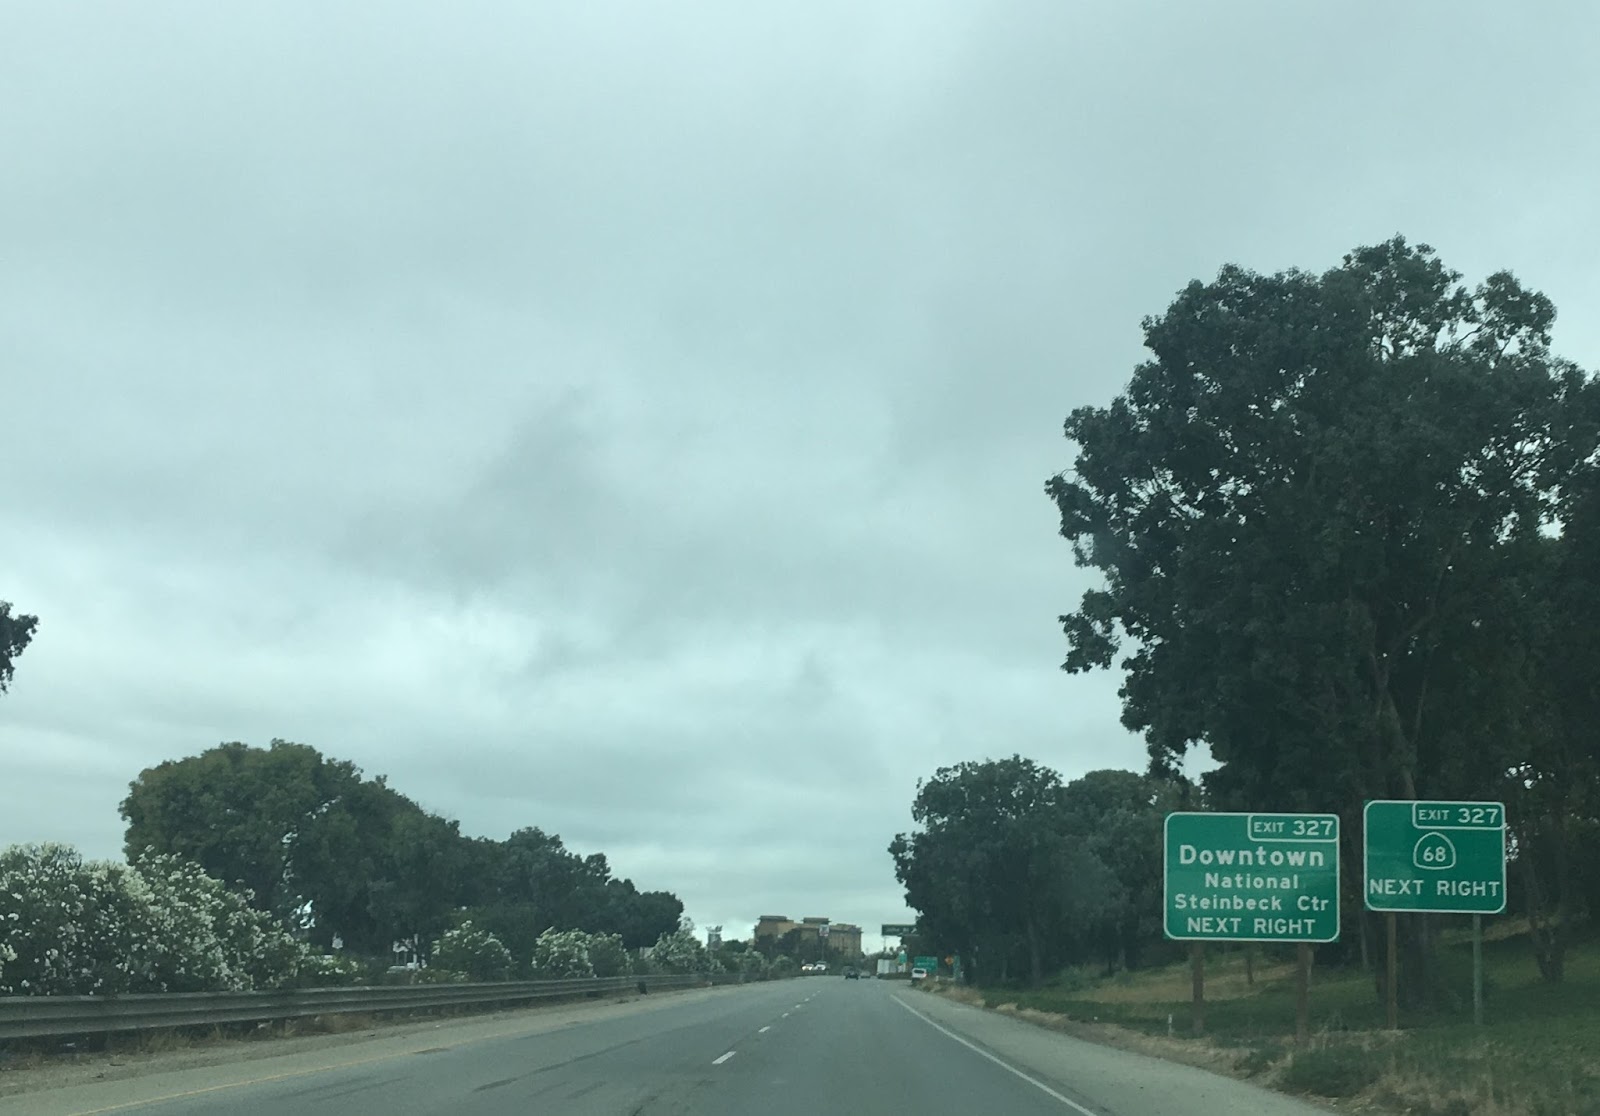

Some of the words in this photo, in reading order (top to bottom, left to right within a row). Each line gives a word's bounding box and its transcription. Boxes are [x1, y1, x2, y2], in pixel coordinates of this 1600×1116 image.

[1418, 809, 1450, 821] EXIT
[1458, 808, 1499, 824] 327
[1254, 822, 1285, 833] EXIT
[1293, 820, 1334, 836] 327
[1179, 844, 1324, 867] Downtown
[1423, 846, 1446, 862] 68
[1205, 873, 1299, 889] National
[1369, 879, 1424, 895] NEXT
[1436, 880, 1500, 897] RIGHT
[1174, 893, 1282, 911] Steinbeck
[1297, 896, 1329, 911] Ctr
[1187, 917, 1242, 933] NEXT
[1254, 918, 1316, 934] RIGHT
